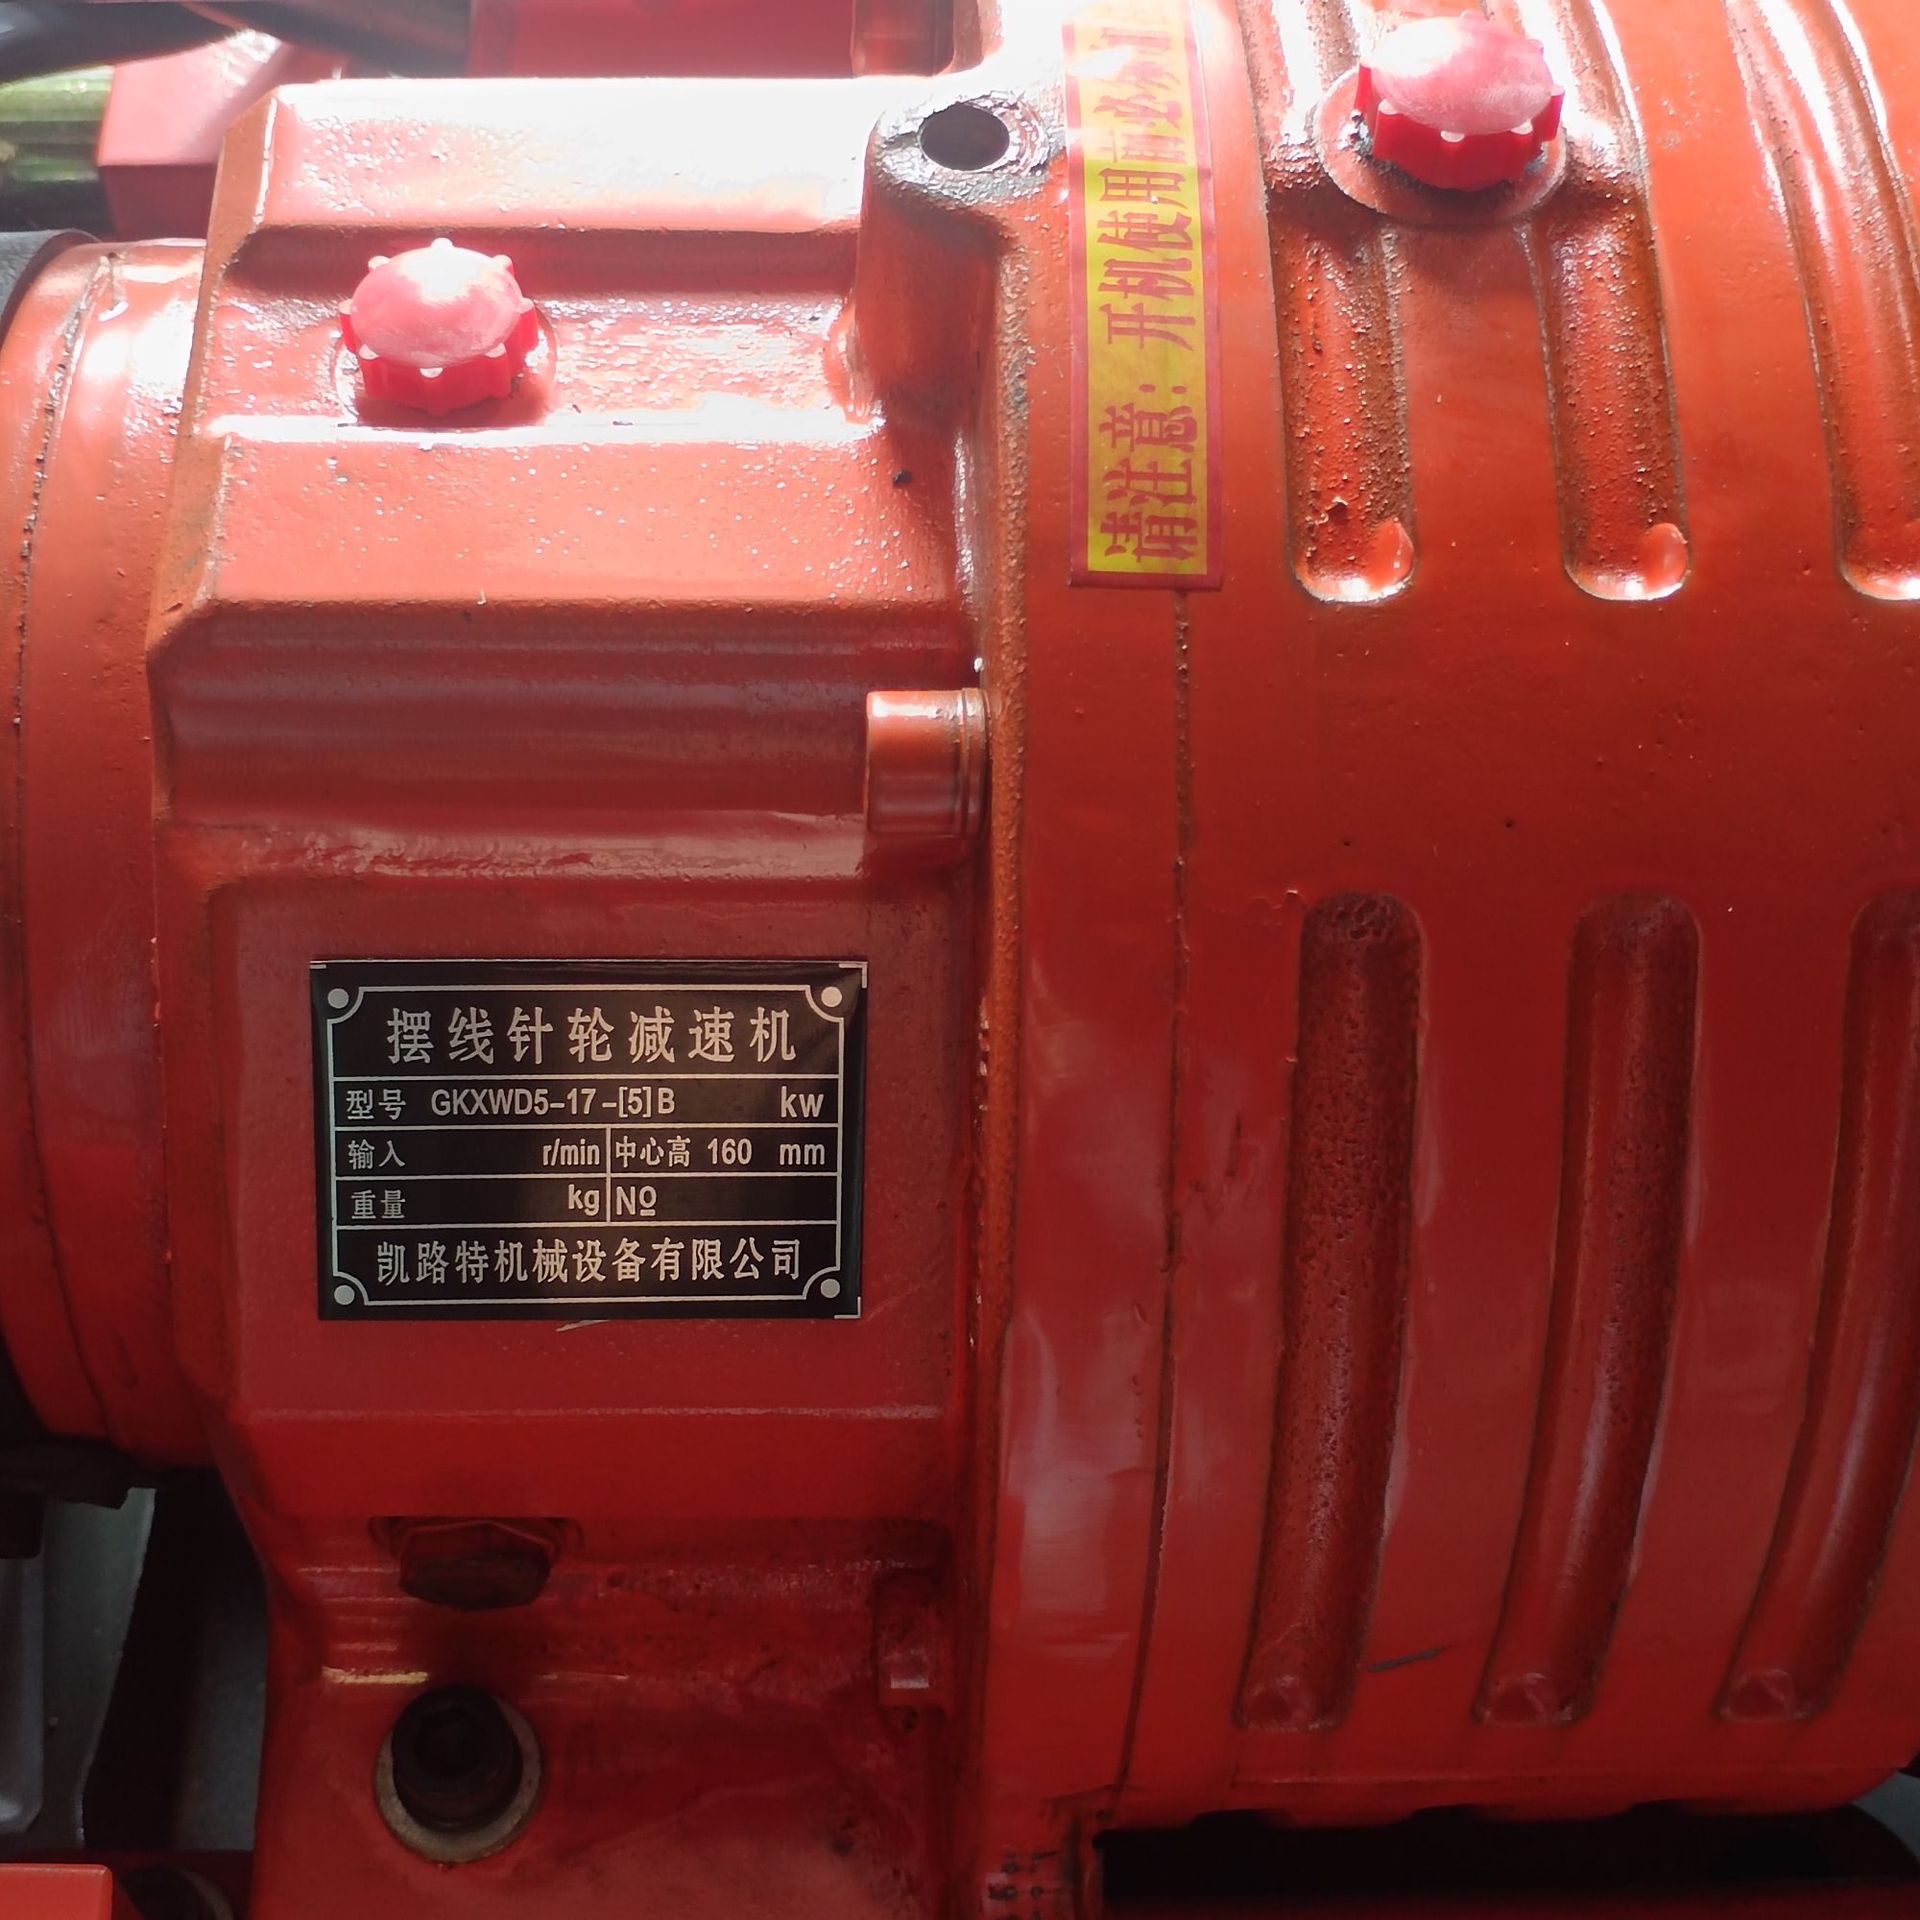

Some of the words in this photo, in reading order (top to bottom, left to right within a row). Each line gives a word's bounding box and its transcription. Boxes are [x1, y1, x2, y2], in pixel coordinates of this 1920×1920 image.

[386, 1006, 797, 1064] 摆线针轮减速机
[346, 1088, 406, 1121] 型号
[780, 1086, 824, 1118] kw
[348, 1138, 406, 1170] 输入
[542, 1138, 600, 1166] r/min
[615, 1135, 691, 1168] 中心高
[707, 1138, 753, 1165] 160
[779, 1143, 825, 1166] mm
[351, 1189, 406, 1220] 重量
[568, 1183, 600, 1216] kg
[377, 1236, 801, 1286] 凯路特机械设备有限公司
